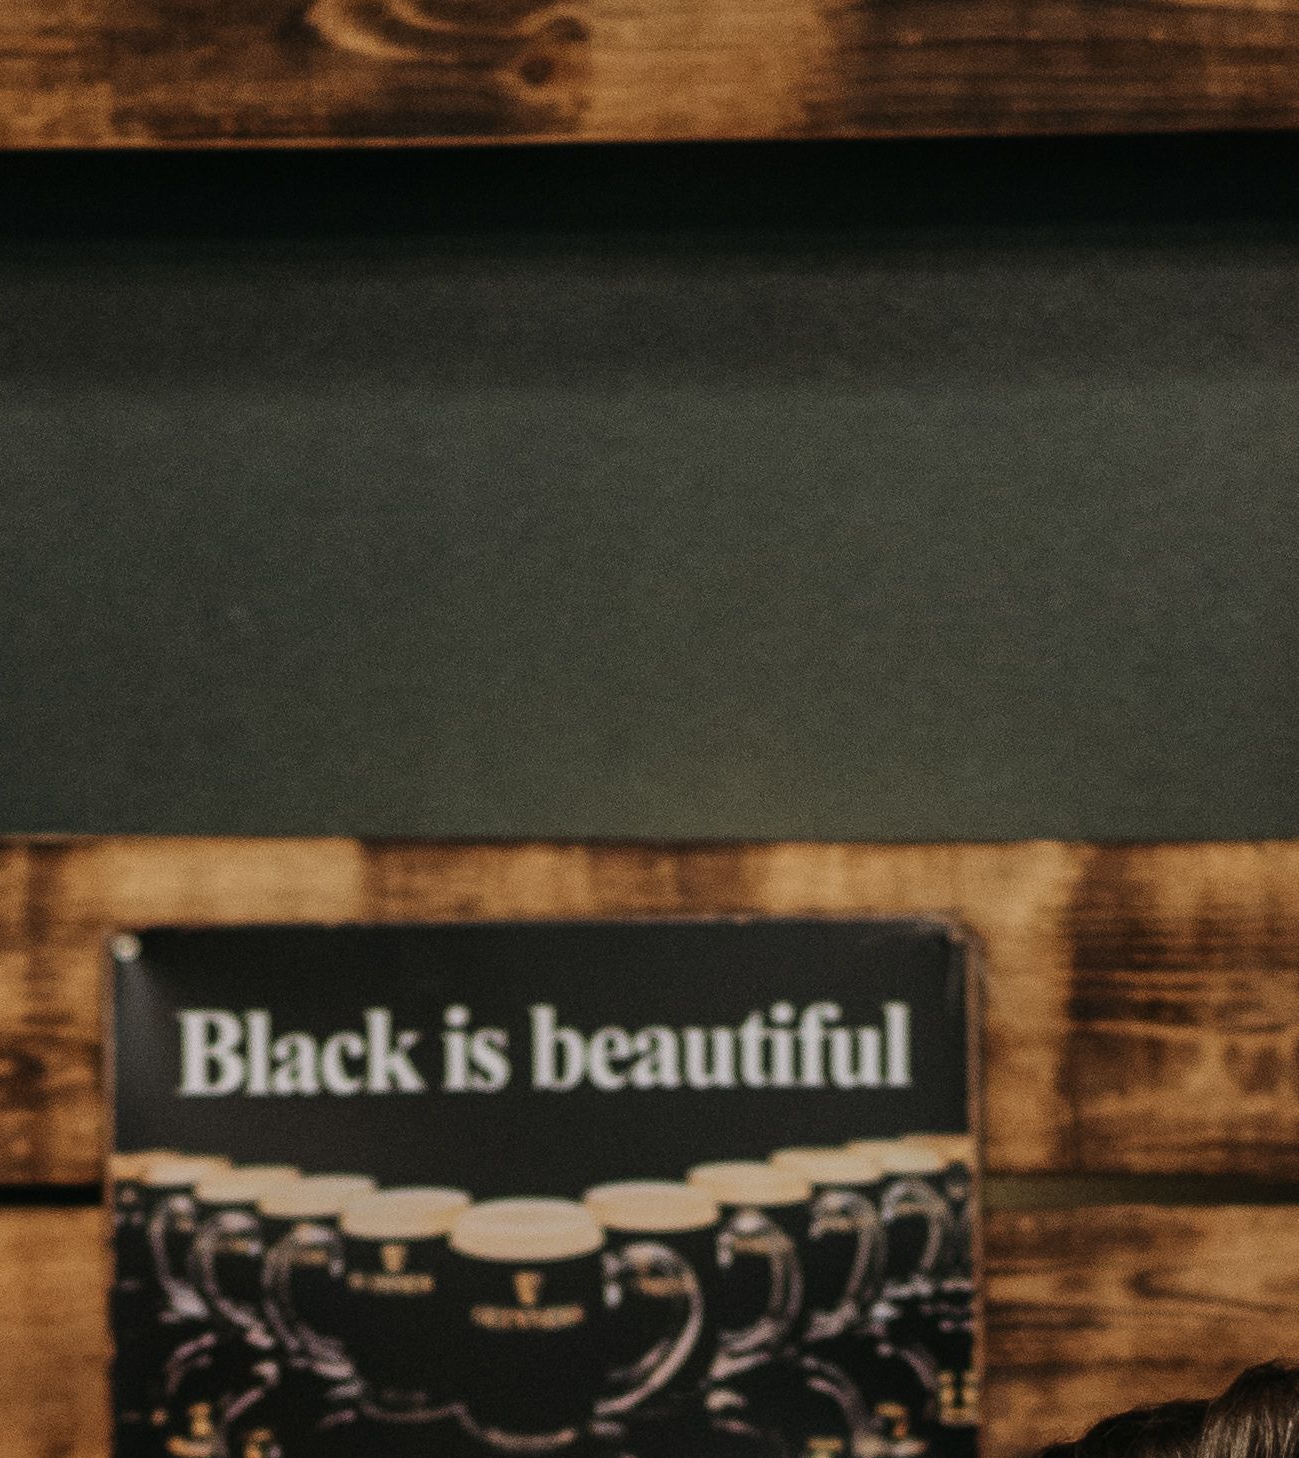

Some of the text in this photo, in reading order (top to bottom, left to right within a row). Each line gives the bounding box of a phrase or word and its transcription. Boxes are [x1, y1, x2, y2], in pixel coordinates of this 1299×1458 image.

[177, 999, 911, 1096] Black is beautiful
